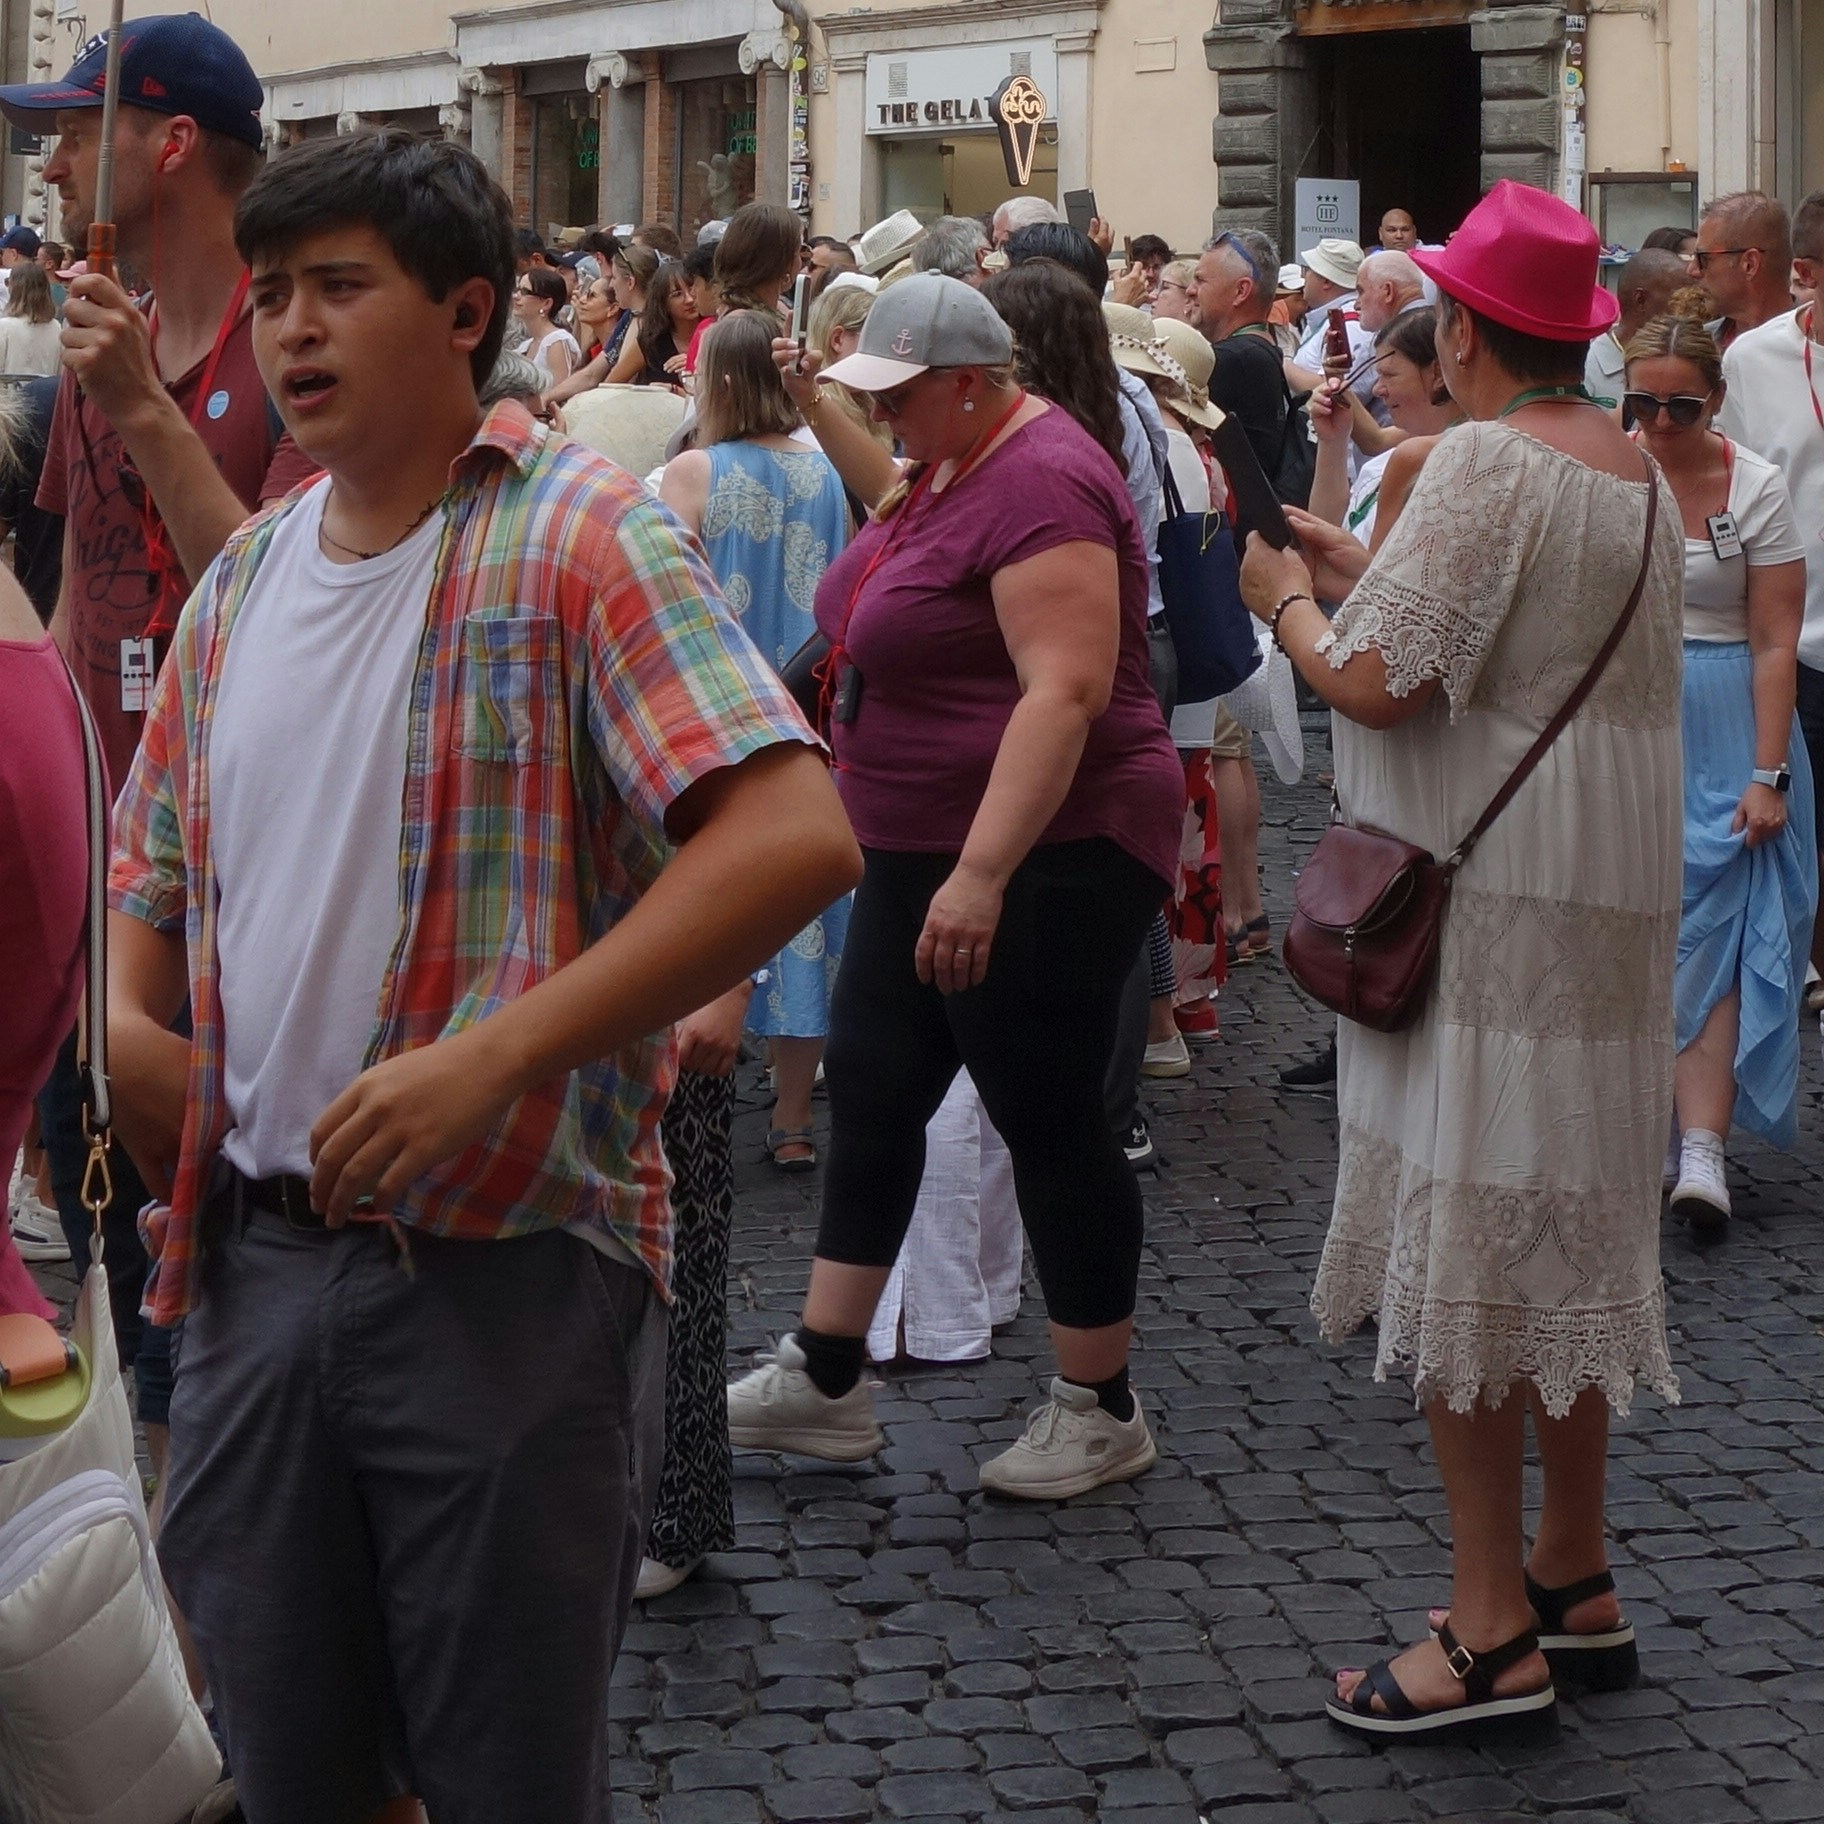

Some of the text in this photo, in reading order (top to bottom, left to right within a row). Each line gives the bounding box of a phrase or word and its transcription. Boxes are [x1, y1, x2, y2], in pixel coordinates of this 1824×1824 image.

[813, 69, 826, 85] 95
[877, 102, 918, 125] THE
[730, 137, 744, 154] OF
[579, 151, 592, 168] OF
[1319, 208, 1336, 219] HF
